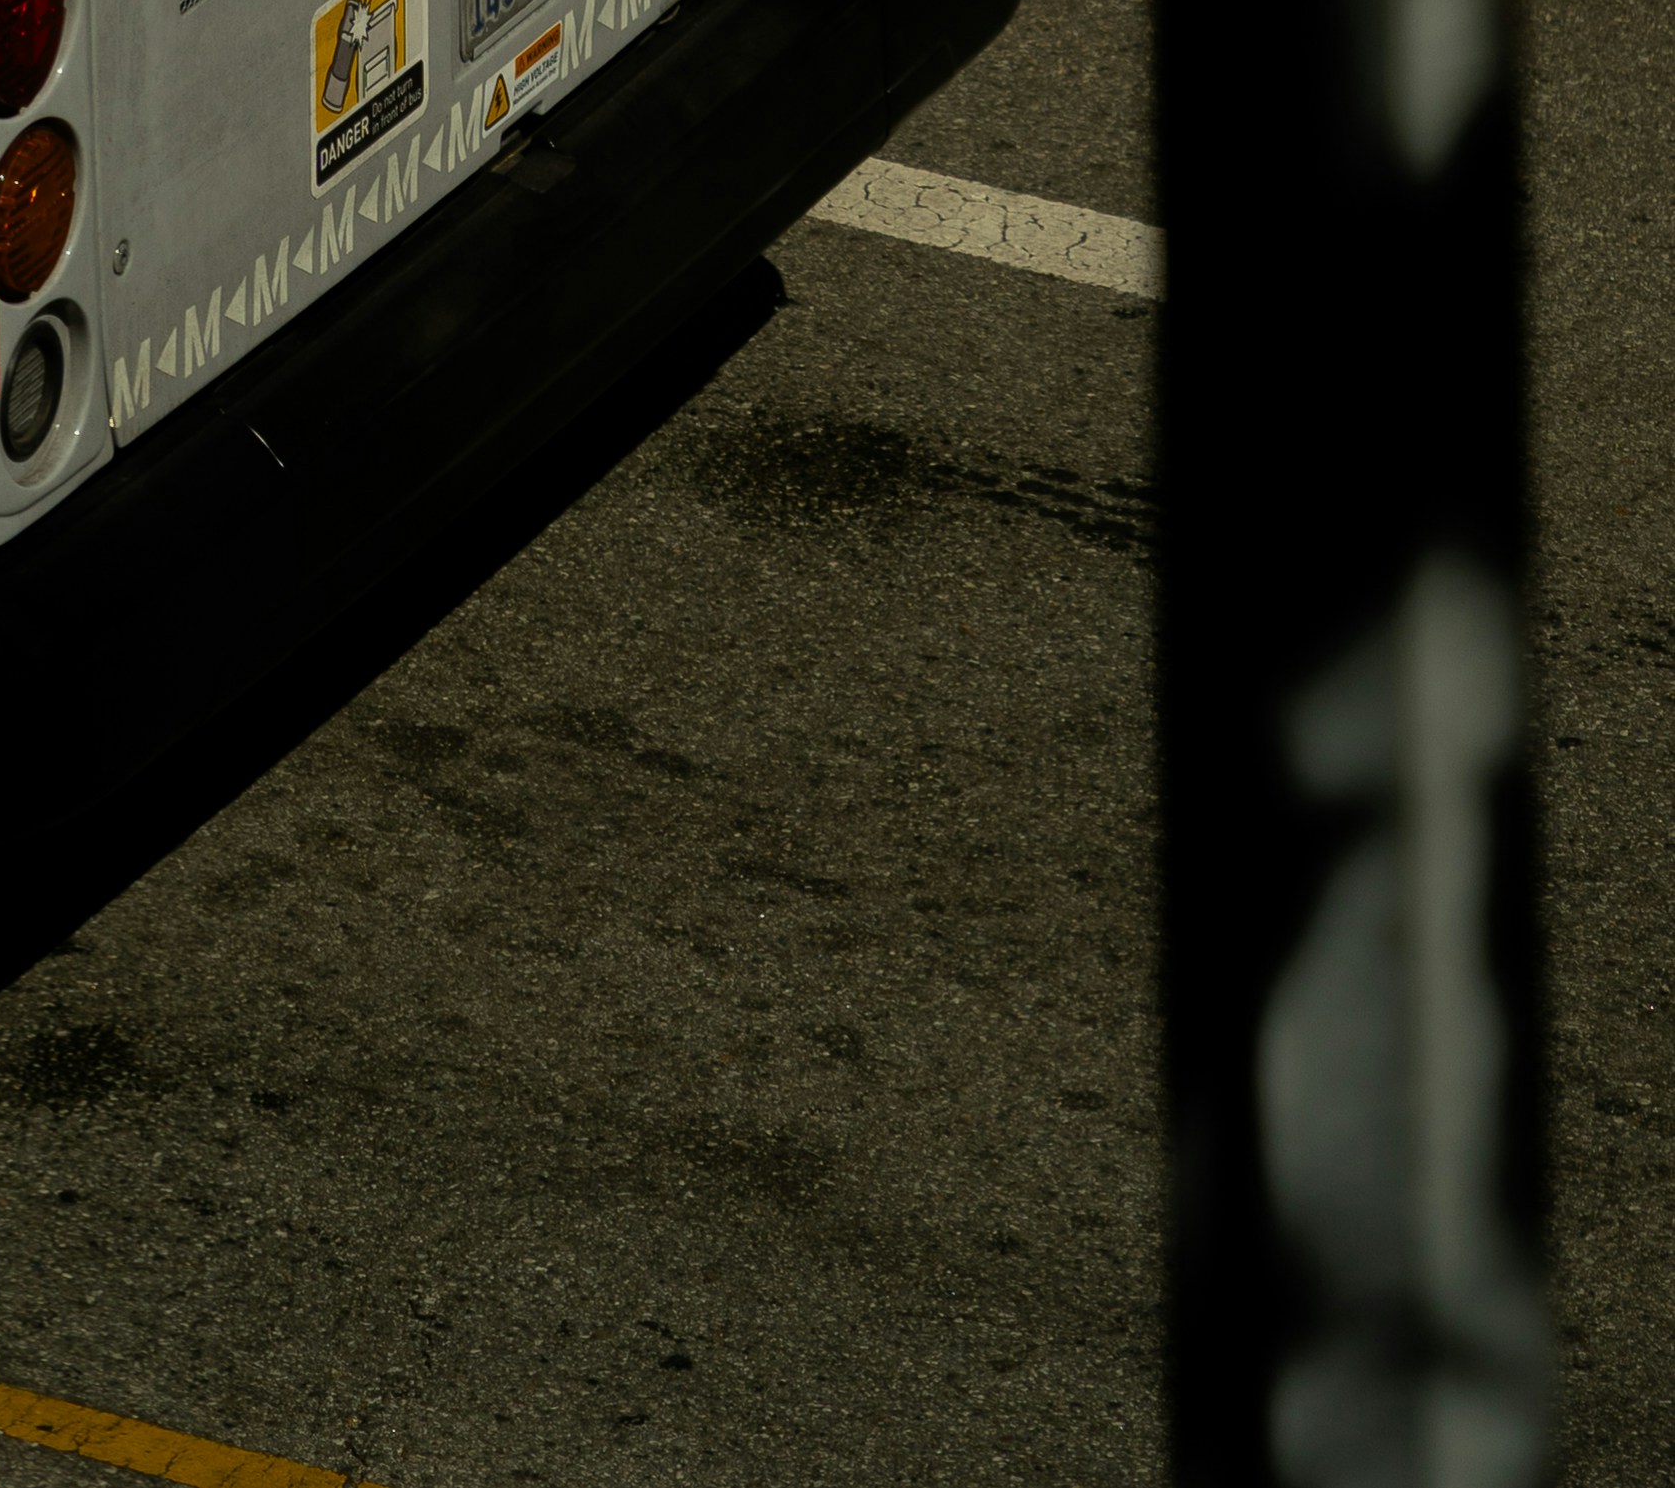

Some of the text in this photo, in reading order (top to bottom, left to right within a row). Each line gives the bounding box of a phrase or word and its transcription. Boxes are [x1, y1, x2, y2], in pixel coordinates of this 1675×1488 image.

[371, 88, 422, 136] in front of bus
[372, 78, 413, 118] Do not turn
[320, 116, 370, 171] DANGER
